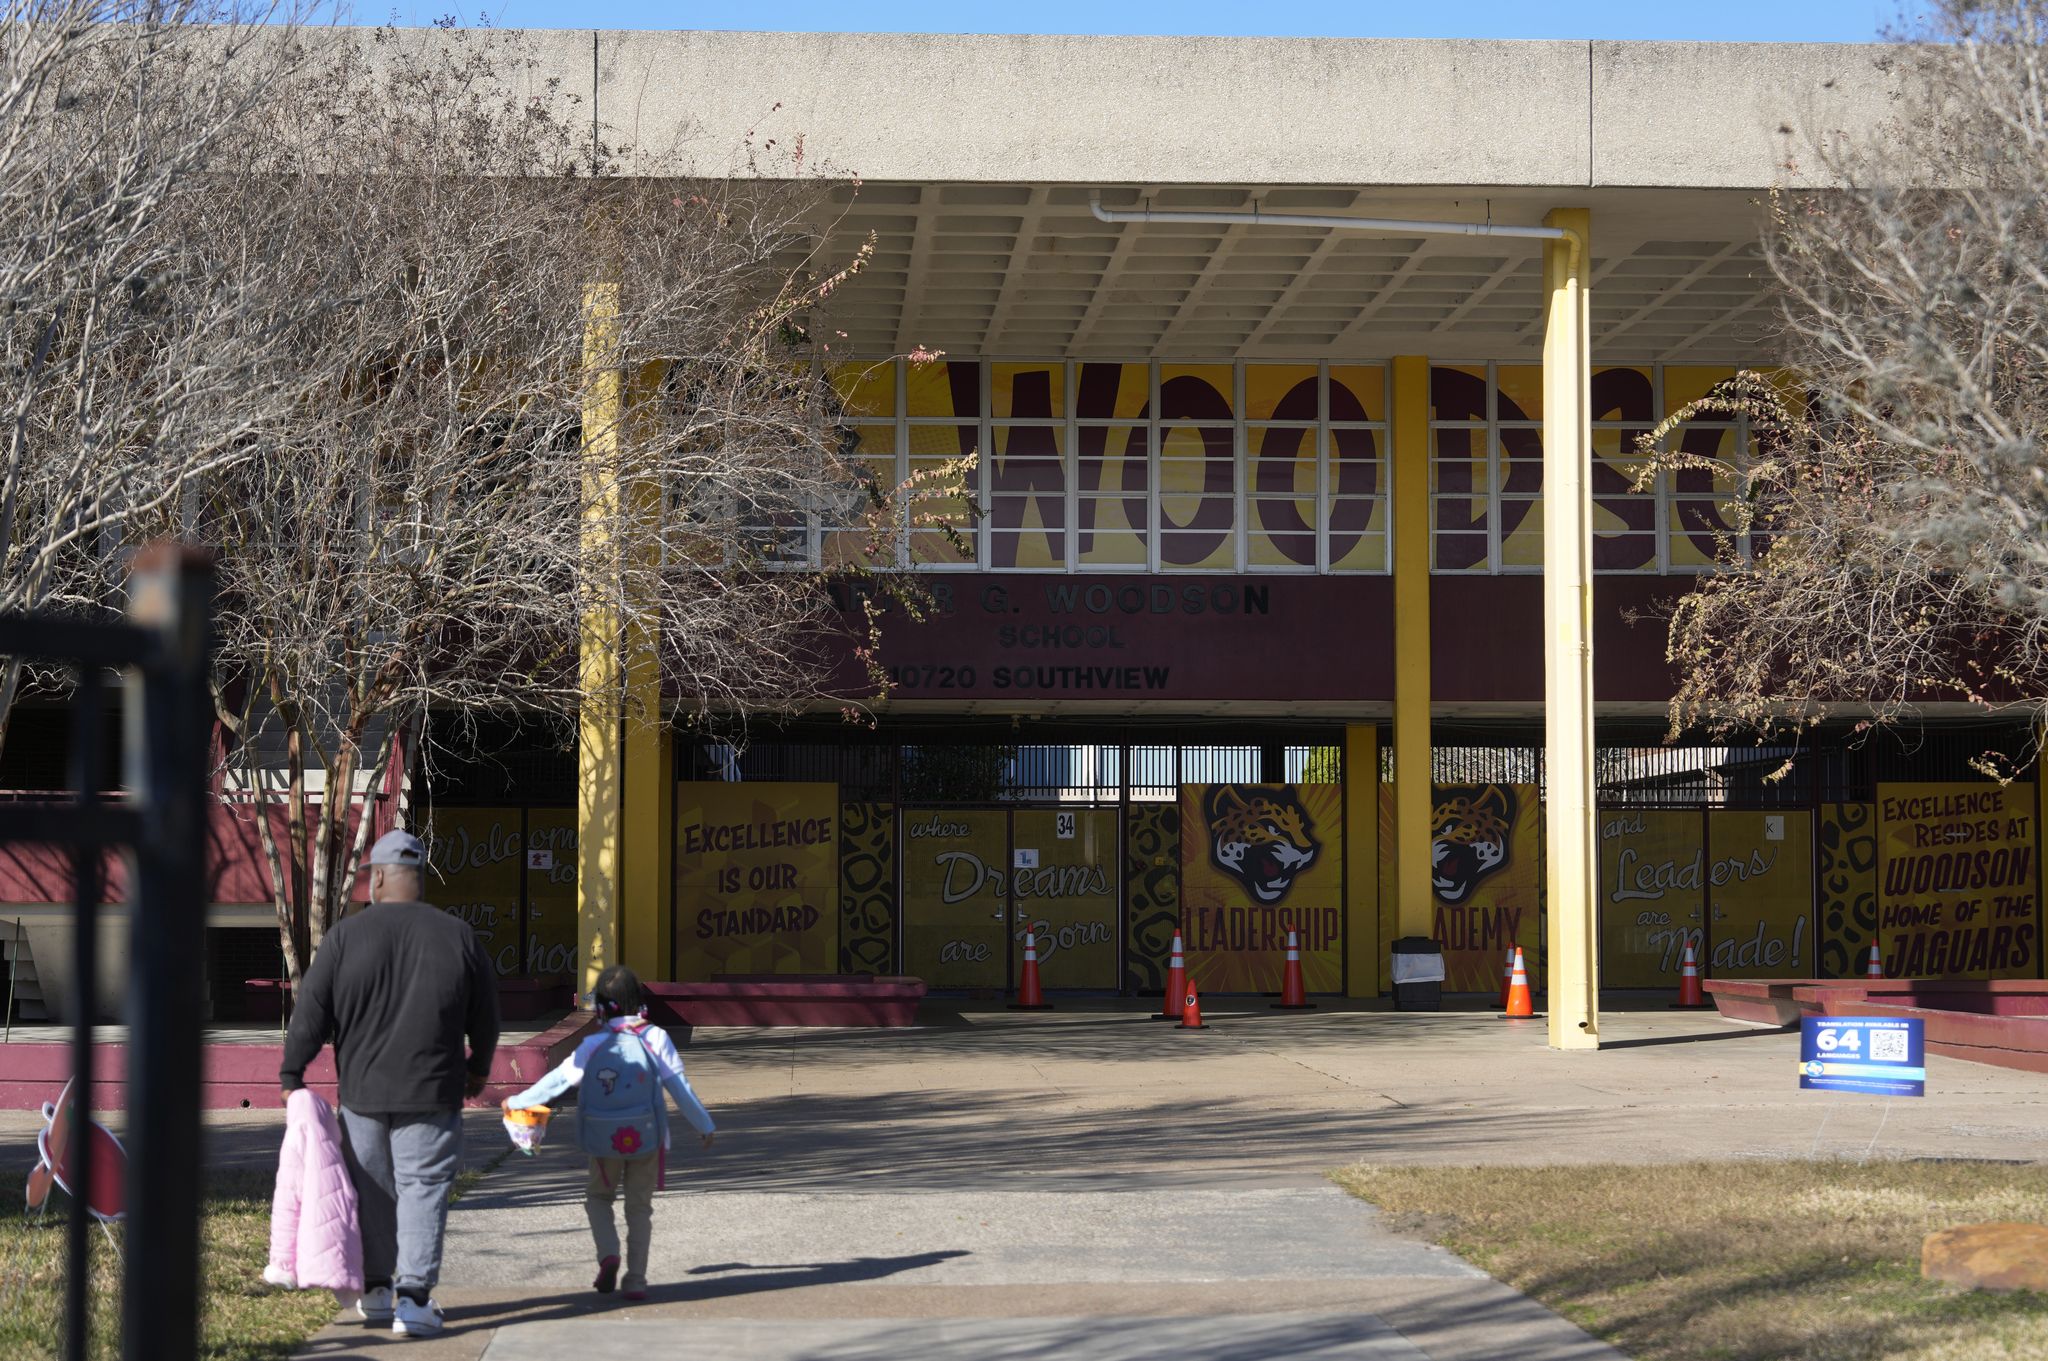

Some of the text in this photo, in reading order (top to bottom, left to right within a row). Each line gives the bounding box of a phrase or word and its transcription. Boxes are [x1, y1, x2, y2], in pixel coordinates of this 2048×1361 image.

[981, 584, 1020, 614] G.
[1045, 584, 1269, 614] WOODSON
[998, 624, 1125, 649] SCHOOL
[992, 666, 1170, 690] SOUTHVIEW
[1883, 790, 2004, 823] EXCELLENCE
[684, 816, 832, 854] EXCELLENCE
[910, 815, 971, 839] where
[1058, 815, 1074, 835] 34
[1602, 812, 1647, 841] and
[1767, 823, 1774, 833] K
[1915, 817, 2029, 848] RESIDES AT
[426, 822, 578, 876] Welcom
[547, 857, 576, 884] to
[718, 862, 798, 894] IS OUR
[934, 850, 1113, 904] Dreams
[1611, 846, 1778, 903] Leaders
[1885, 846, 2031, 897] WOODSON
[696, 905, 819, 940] STANDARD
[1636, 910, 1672, 927] are
[1882, 894, 2034, 930] HOME OF THE
[1014, 918, 1112, 966] Born
[1184, 906, 1339, 952] LEADERSHIP
[1432, 906, 1523, 952] ADEMY
[1649, 914, 1808, 975] Made!
[940, 938, 992, 965] are
[1884, 922, 2034, 979] JAGUARS
[1816, 1028, 1862, 1051] 64
